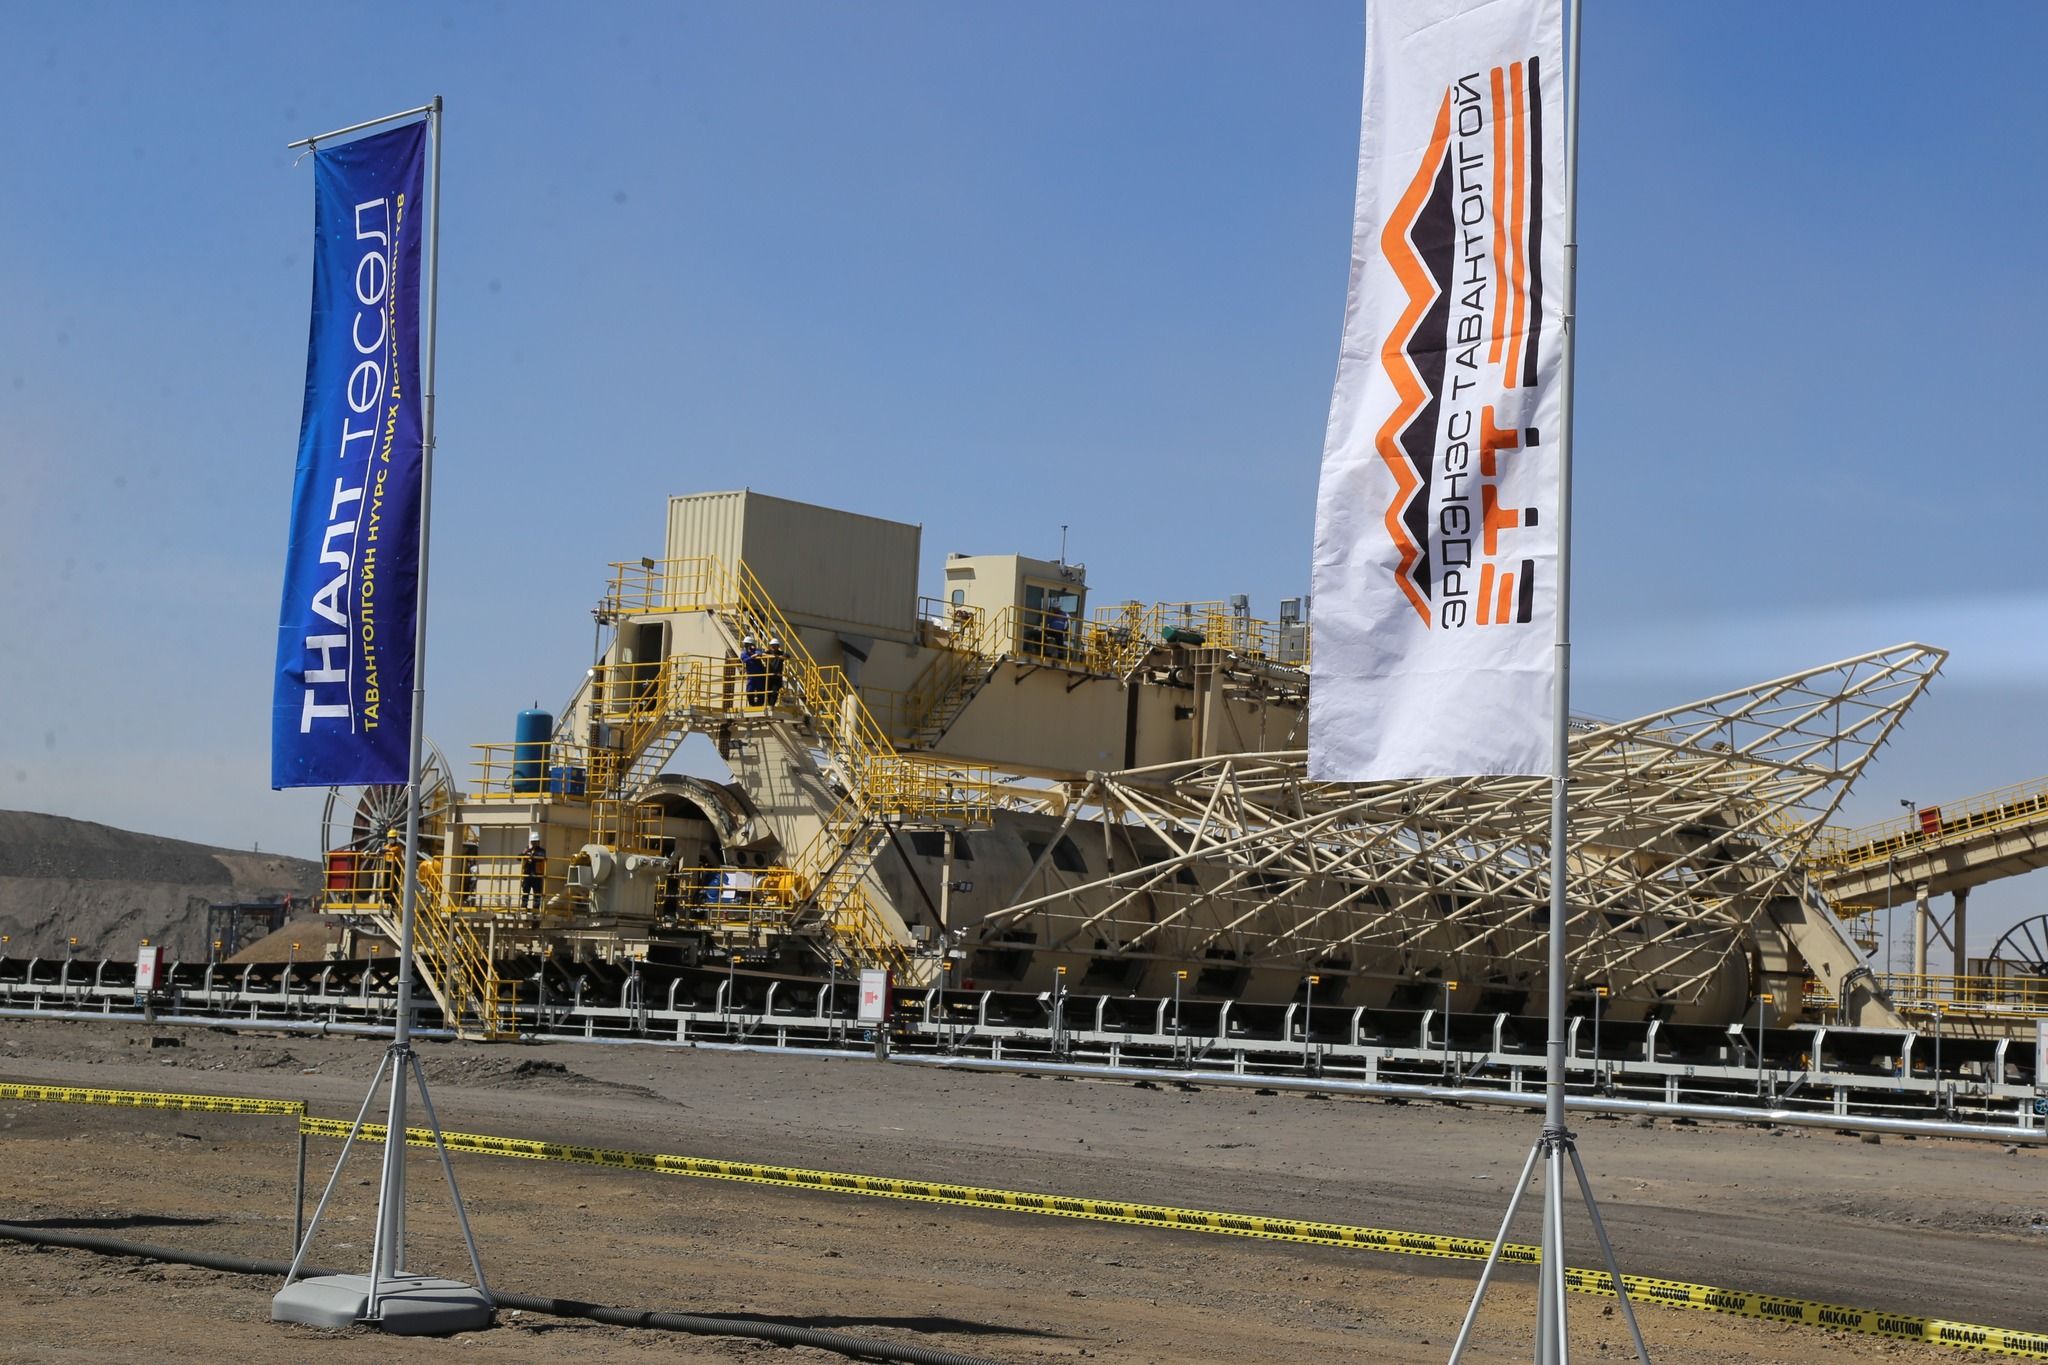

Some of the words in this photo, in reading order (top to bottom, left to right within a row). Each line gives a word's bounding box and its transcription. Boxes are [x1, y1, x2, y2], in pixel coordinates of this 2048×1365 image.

[1450, 71, 1487, 401] ТАВАНТОЛГОЙ
[300, 477, 363, 734] ТНАЛТ
[340, 197, 388, 458] ТӨСӨЛ
[368, 468, 389, 541] НҮҮРС
[381, 405, 398, 463] АЧИХ
[1440, 410, 1472, 630] ЭРДЭНЭС
[360, 547, 380, 731] ТАВАНТОЛГОЙН
[1649, 1285, 1691, 1303] CAUTION
[1760, 1301, 1803, 1319] CAUTION
[1818, 1309, 1862, 1328] АНХААР
[1877, 1317, 1924, 1337] CAUTION
